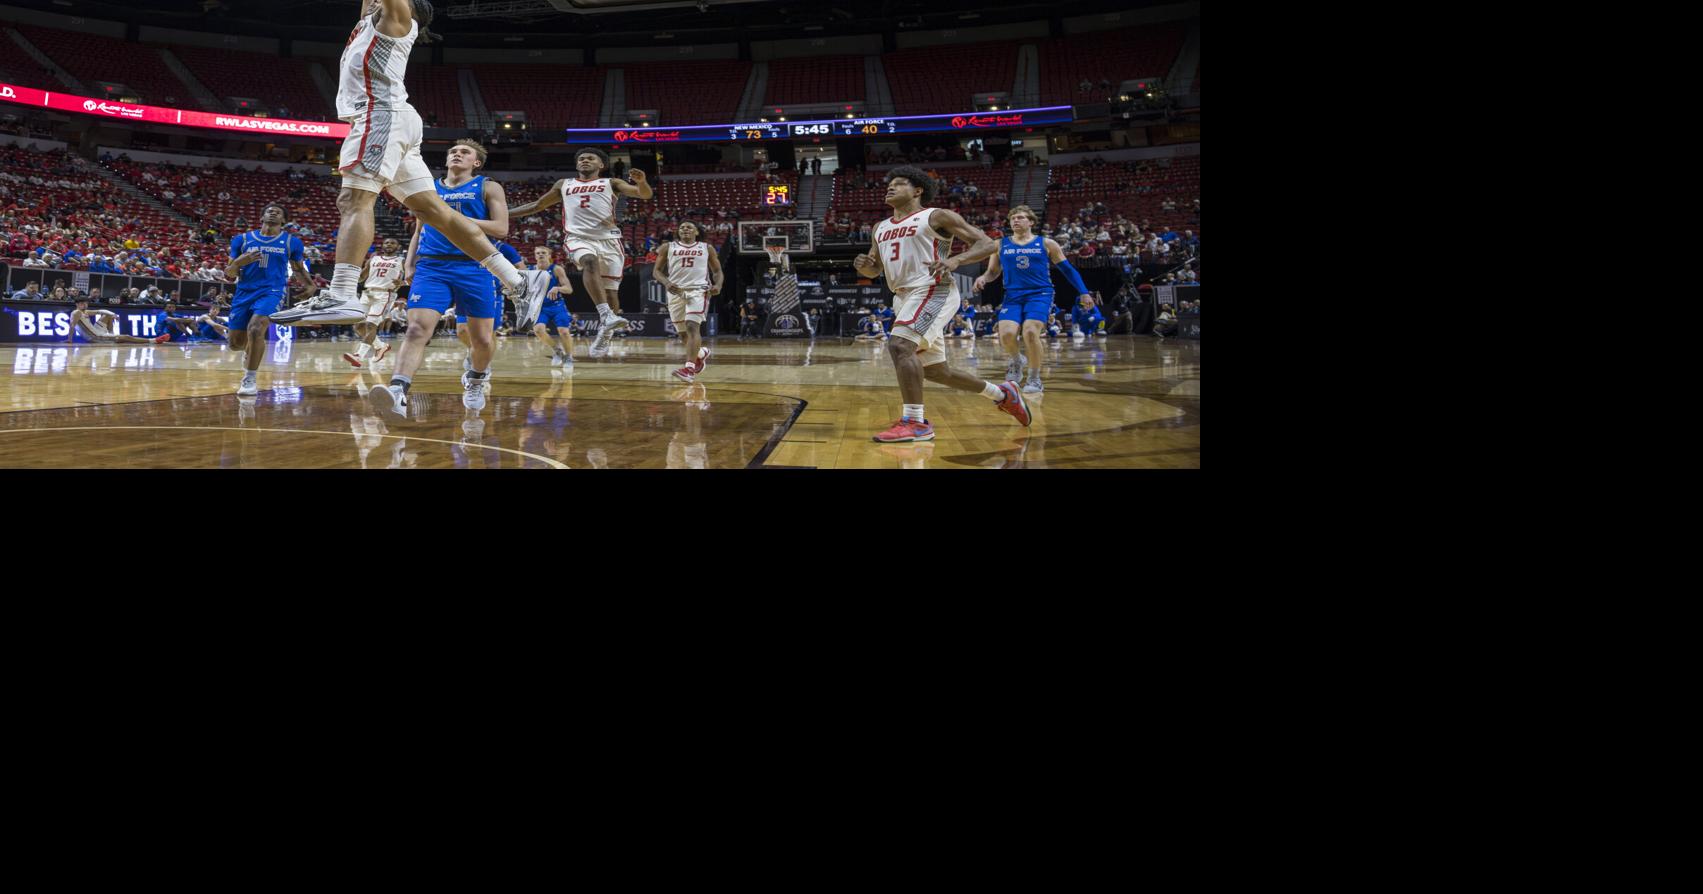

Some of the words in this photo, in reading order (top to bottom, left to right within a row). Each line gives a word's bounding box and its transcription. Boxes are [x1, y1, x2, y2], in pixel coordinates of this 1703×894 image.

[215, 117, 329, 133] RWLASVEGAS.COM
[794, 124, 829, 135] 5:45
[861, 125, 877, 134] 40
[746, 130, 761, 139] 73
[565, 184, 605, 196] LOBOS
[768, 185, 788, 193] 5:45
[443, 192, 476, 200] FORCE
[579, 195, 591, 208] 2
[766, 192, 786, 204] 27
[877, 226, 918, 243] LOBOS
[260, 246, 285, 254] FORCE
[672, 249, 703, 257] LOBOS
[890, 242, 900, 262] 3
[681, 257, 695, 267] 15
[1015, 255, 1030, 270] 3
[375, 268, 388, 278] 12
[18, 311, 75, 336] BES
[128, 315, 157, 336] TH
